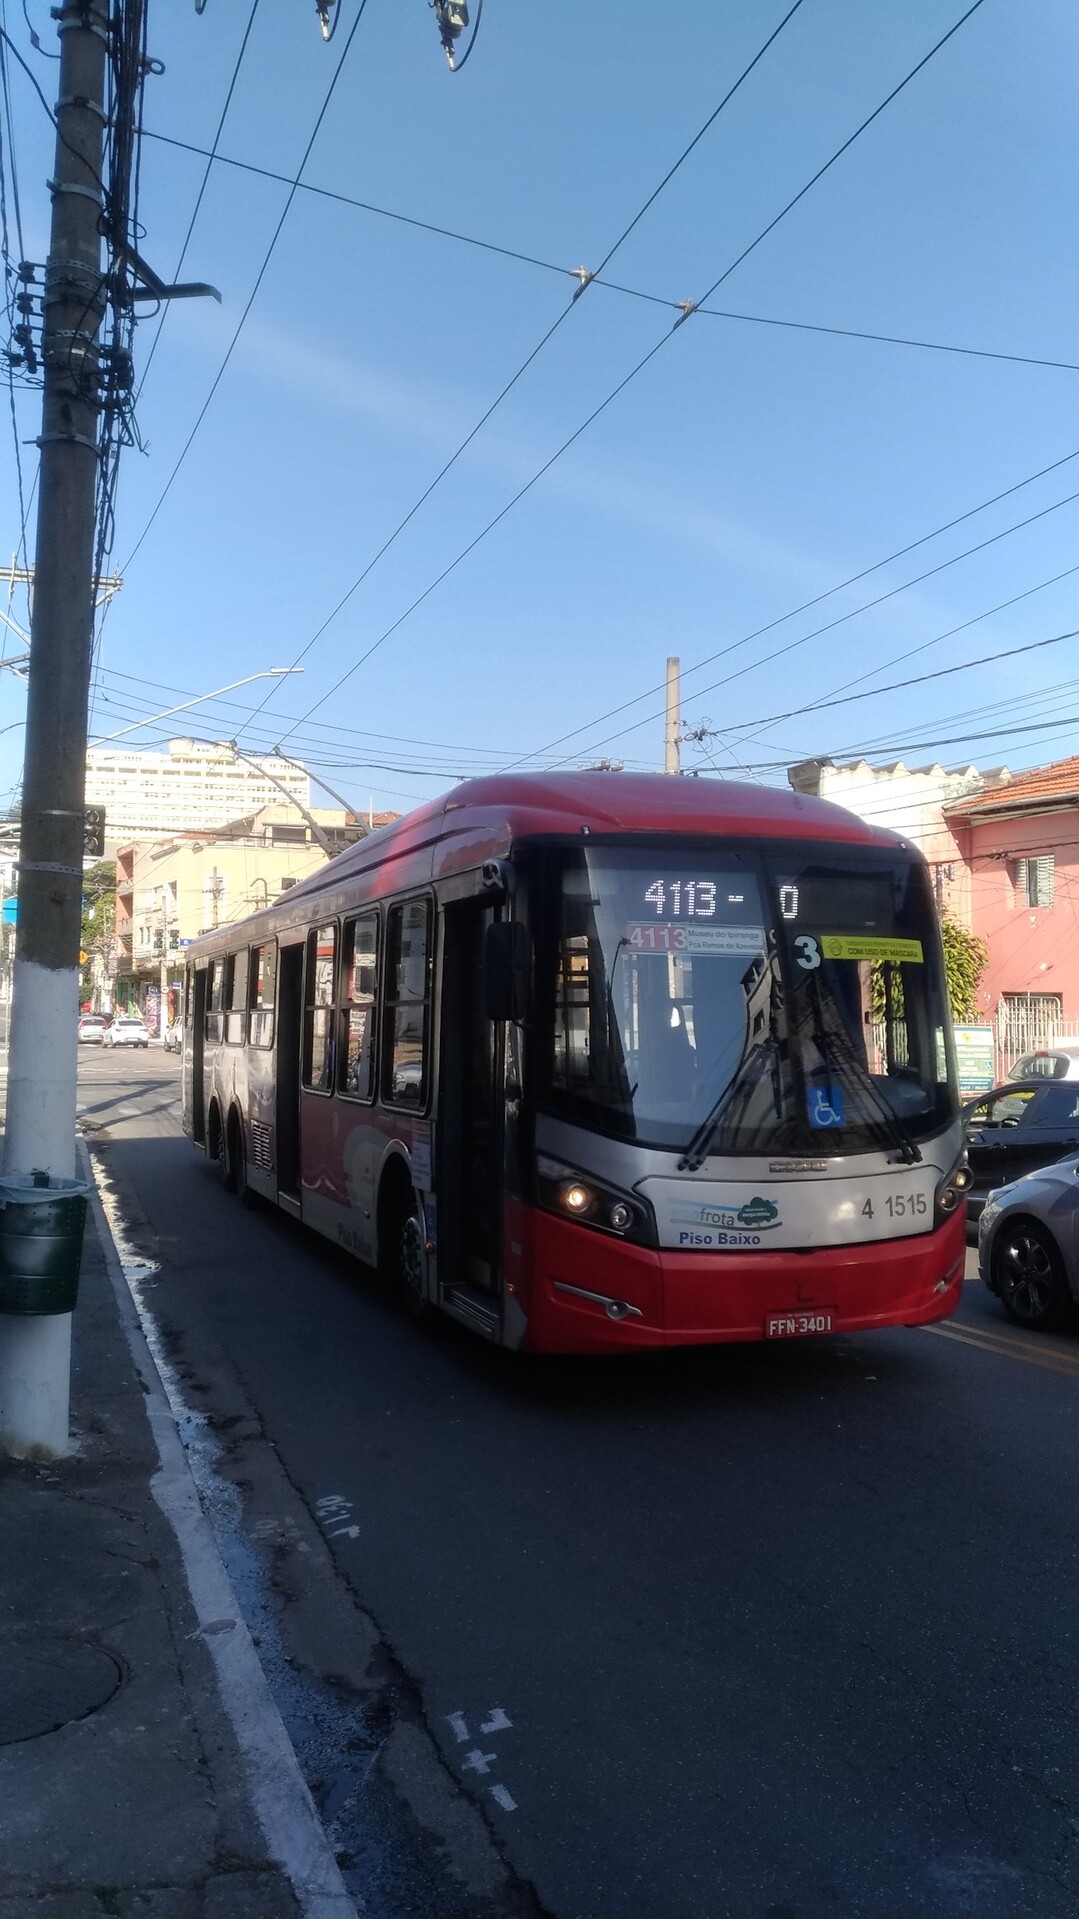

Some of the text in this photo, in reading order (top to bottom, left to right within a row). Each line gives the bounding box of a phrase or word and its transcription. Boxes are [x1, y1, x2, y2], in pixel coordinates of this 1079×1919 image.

[644, 879, 717, 916] 4113
[629, 927, 687, 948] 4113
[688, 930, 714, 938] Museu
[728, 931, 759, 941] Ipiranga
[795, 935, 822, 970] 3
[848, 947, 863, 955] COM
[865, 948, 879, 956] USO
[861, 1193, 927, 1219] 4 1515
[679, 1232, 761, 1245] Piso Baixo
